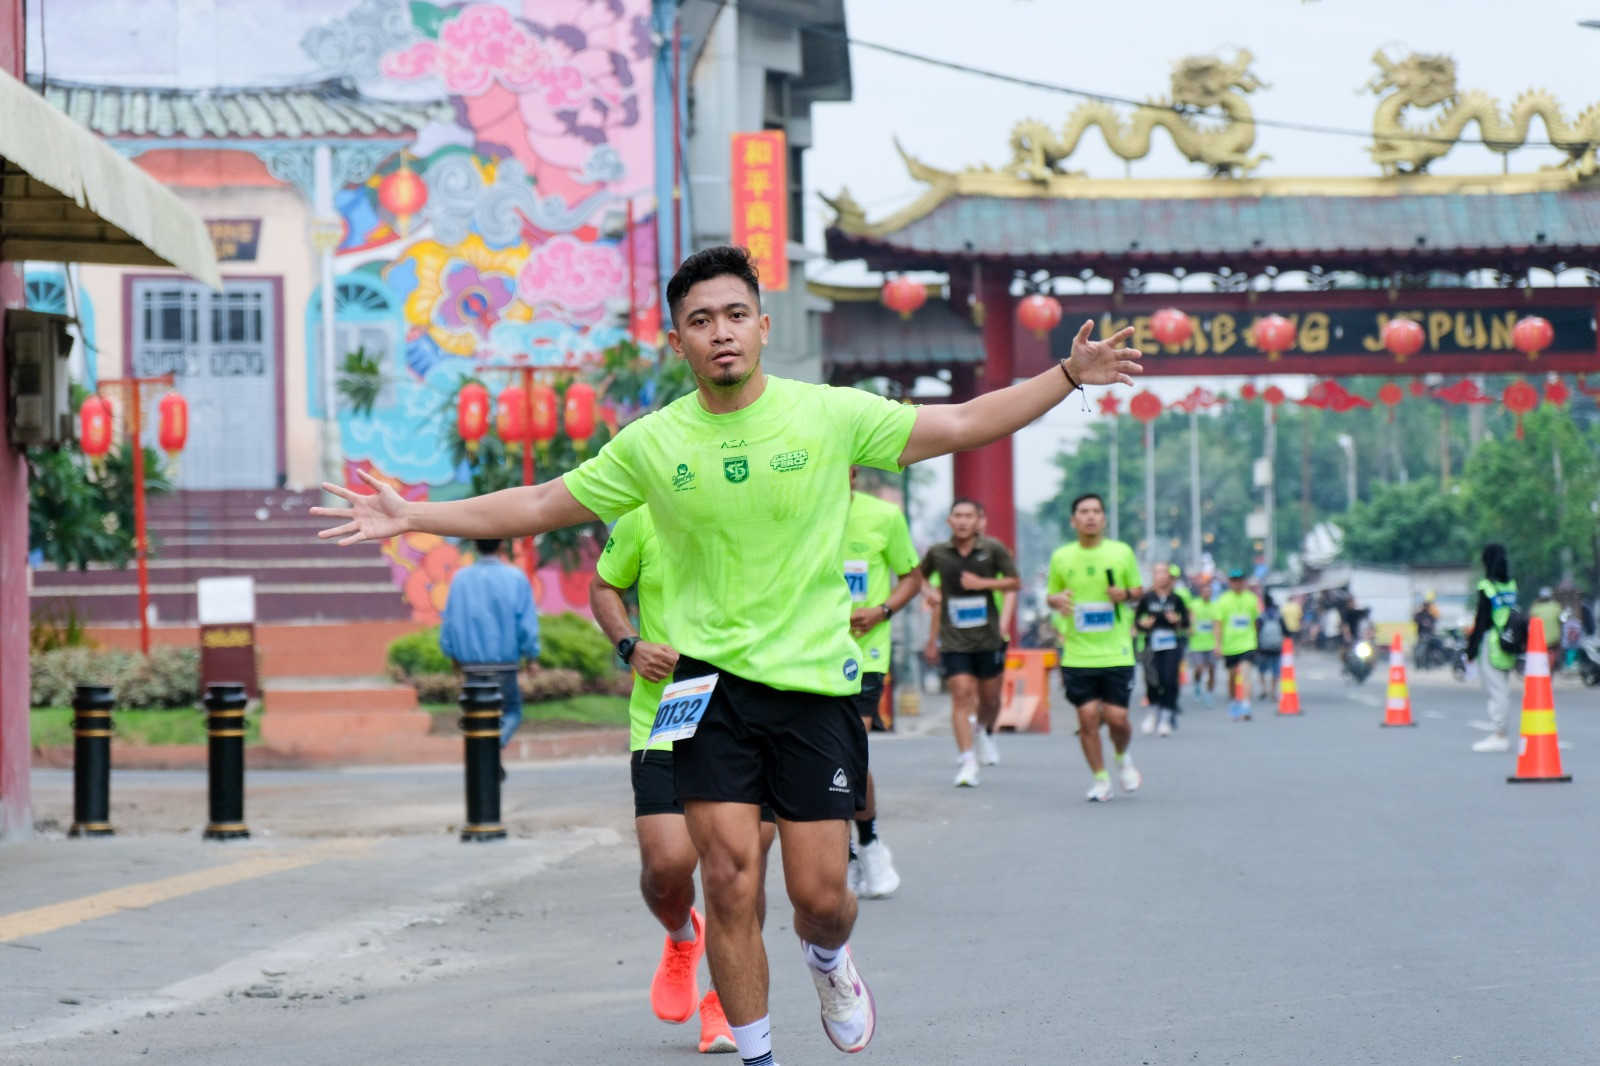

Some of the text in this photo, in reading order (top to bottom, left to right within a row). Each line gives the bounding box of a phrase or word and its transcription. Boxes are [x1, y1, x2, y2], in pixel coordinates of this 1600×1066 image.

[1100, 310, 1517, 354] KEBG JPUN
[844, 575, 863, 591] 71
